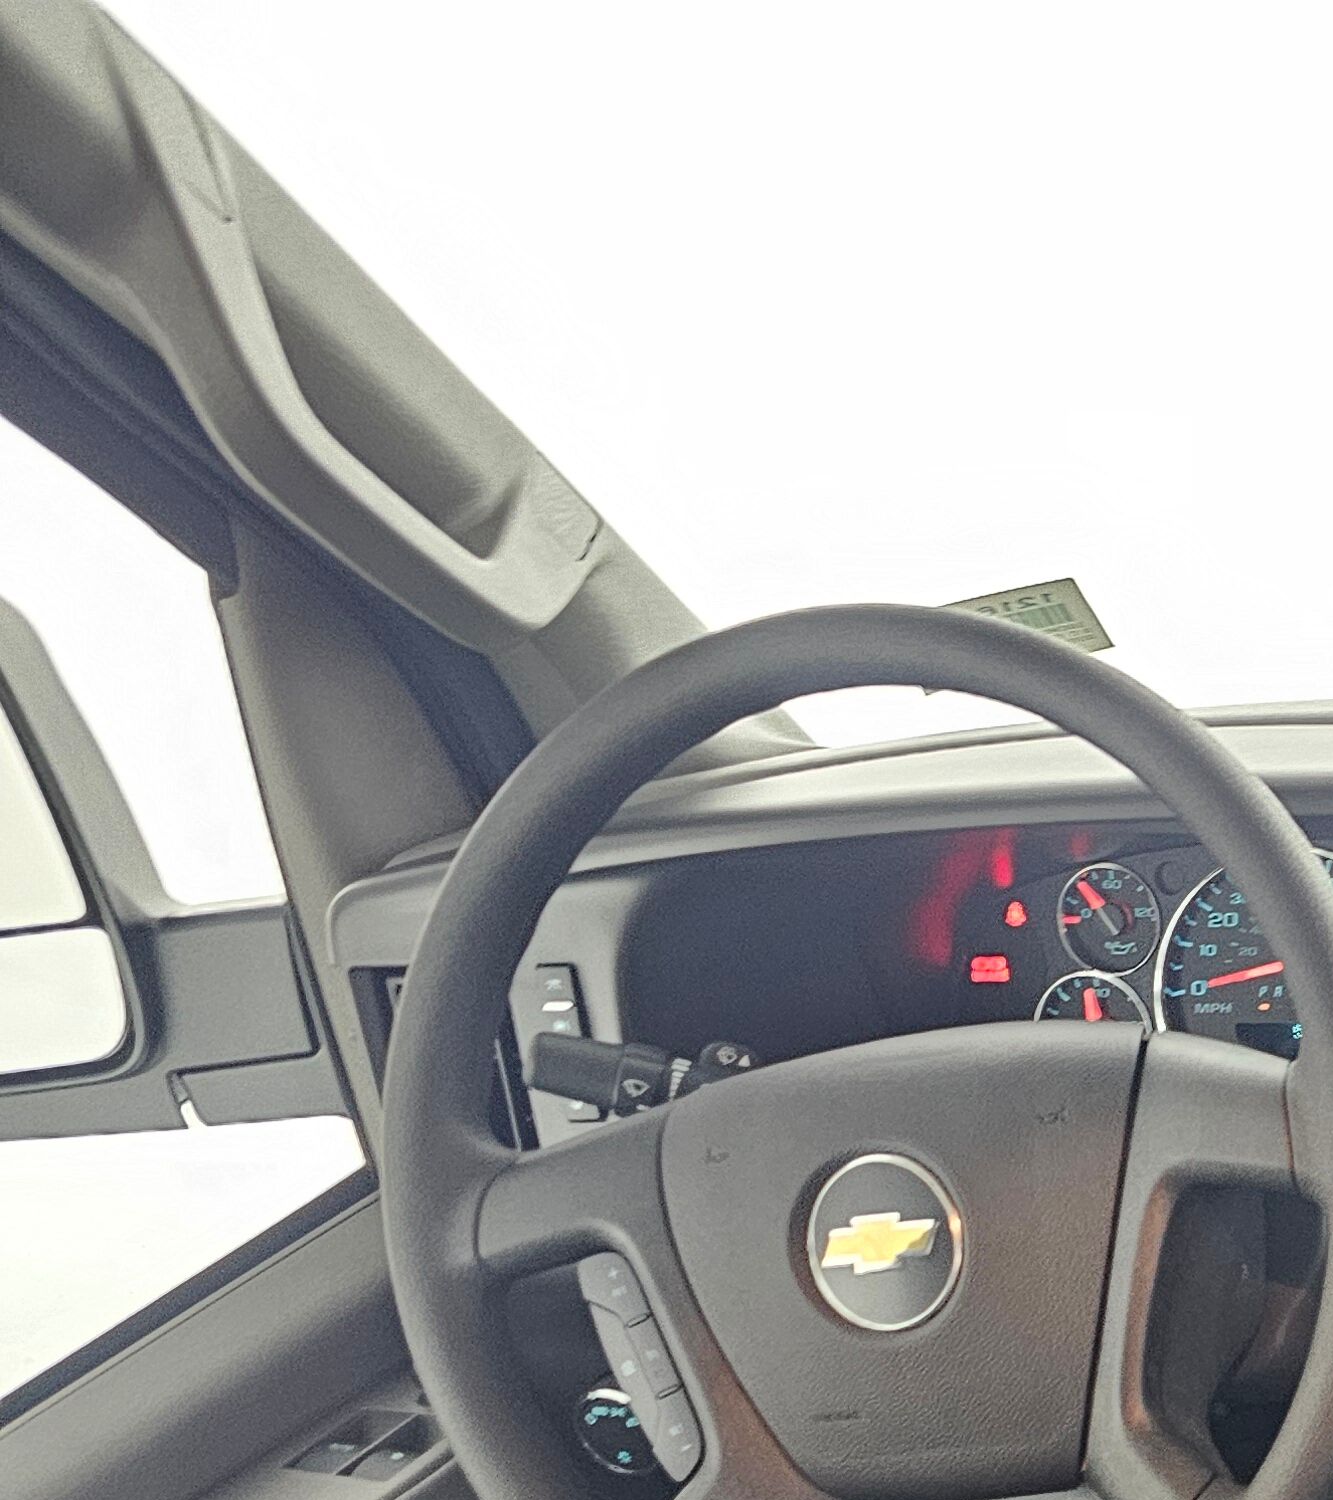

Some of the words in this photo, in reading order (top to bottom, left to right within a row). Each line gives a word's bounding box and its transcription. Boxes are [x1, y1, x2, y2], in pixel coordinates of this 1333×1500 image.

[1207, 912, 1239, 928] 20
[1199, 944, 1218, 957] 10
[1190, 980, 1208, 996] 0
[1194, 1002, 1233, 1014] MPH
